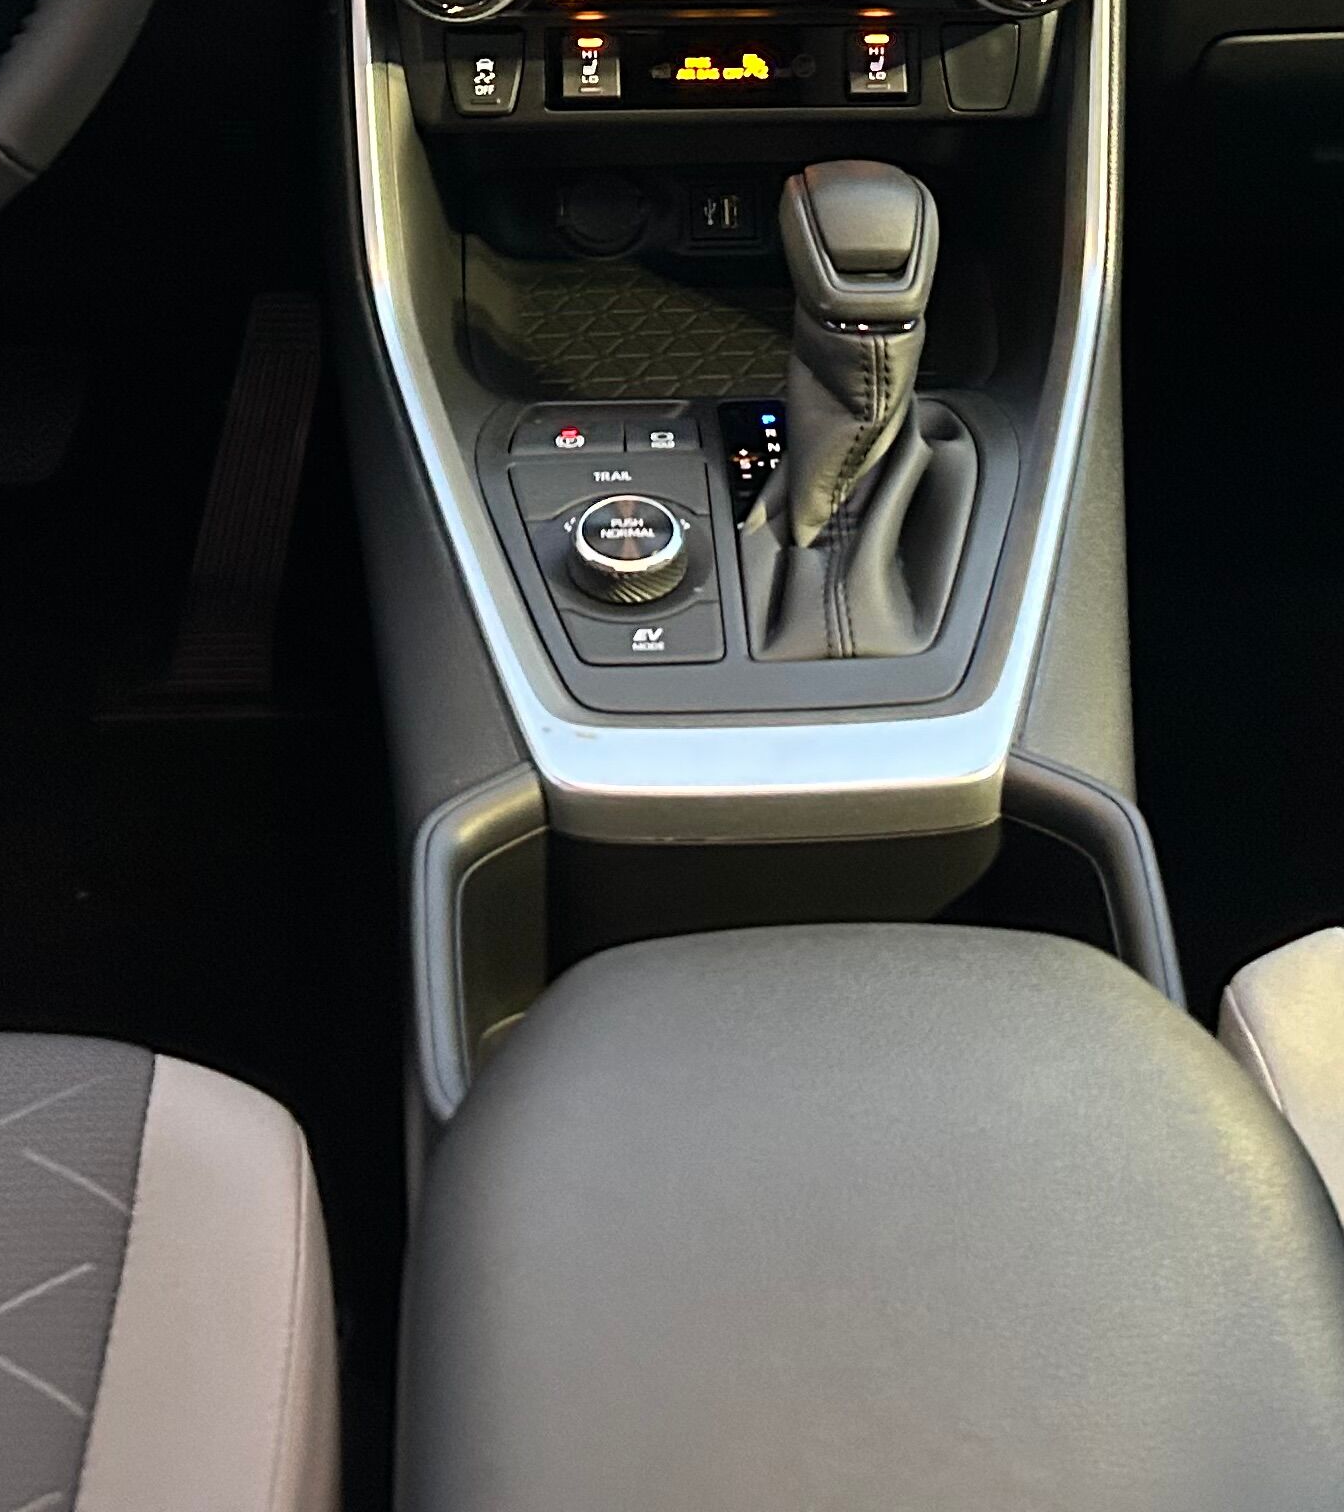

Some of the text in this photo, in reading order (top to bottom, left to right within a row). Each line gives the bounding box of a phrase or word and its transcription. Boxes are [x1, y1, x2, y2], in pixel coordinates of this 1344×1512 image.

[581, 51, 598, 59] HI
[868, 47, 885, 56] HI
[581, 76, 599, 84] LO
[868, 71, 886, 81] LO
[475, 85, 495, 96] OFF
[593, 471, 632, 482] TRAIL
[610, 517, 644, 528] PUSH
[600, 528, 656, 538] NORMAL
